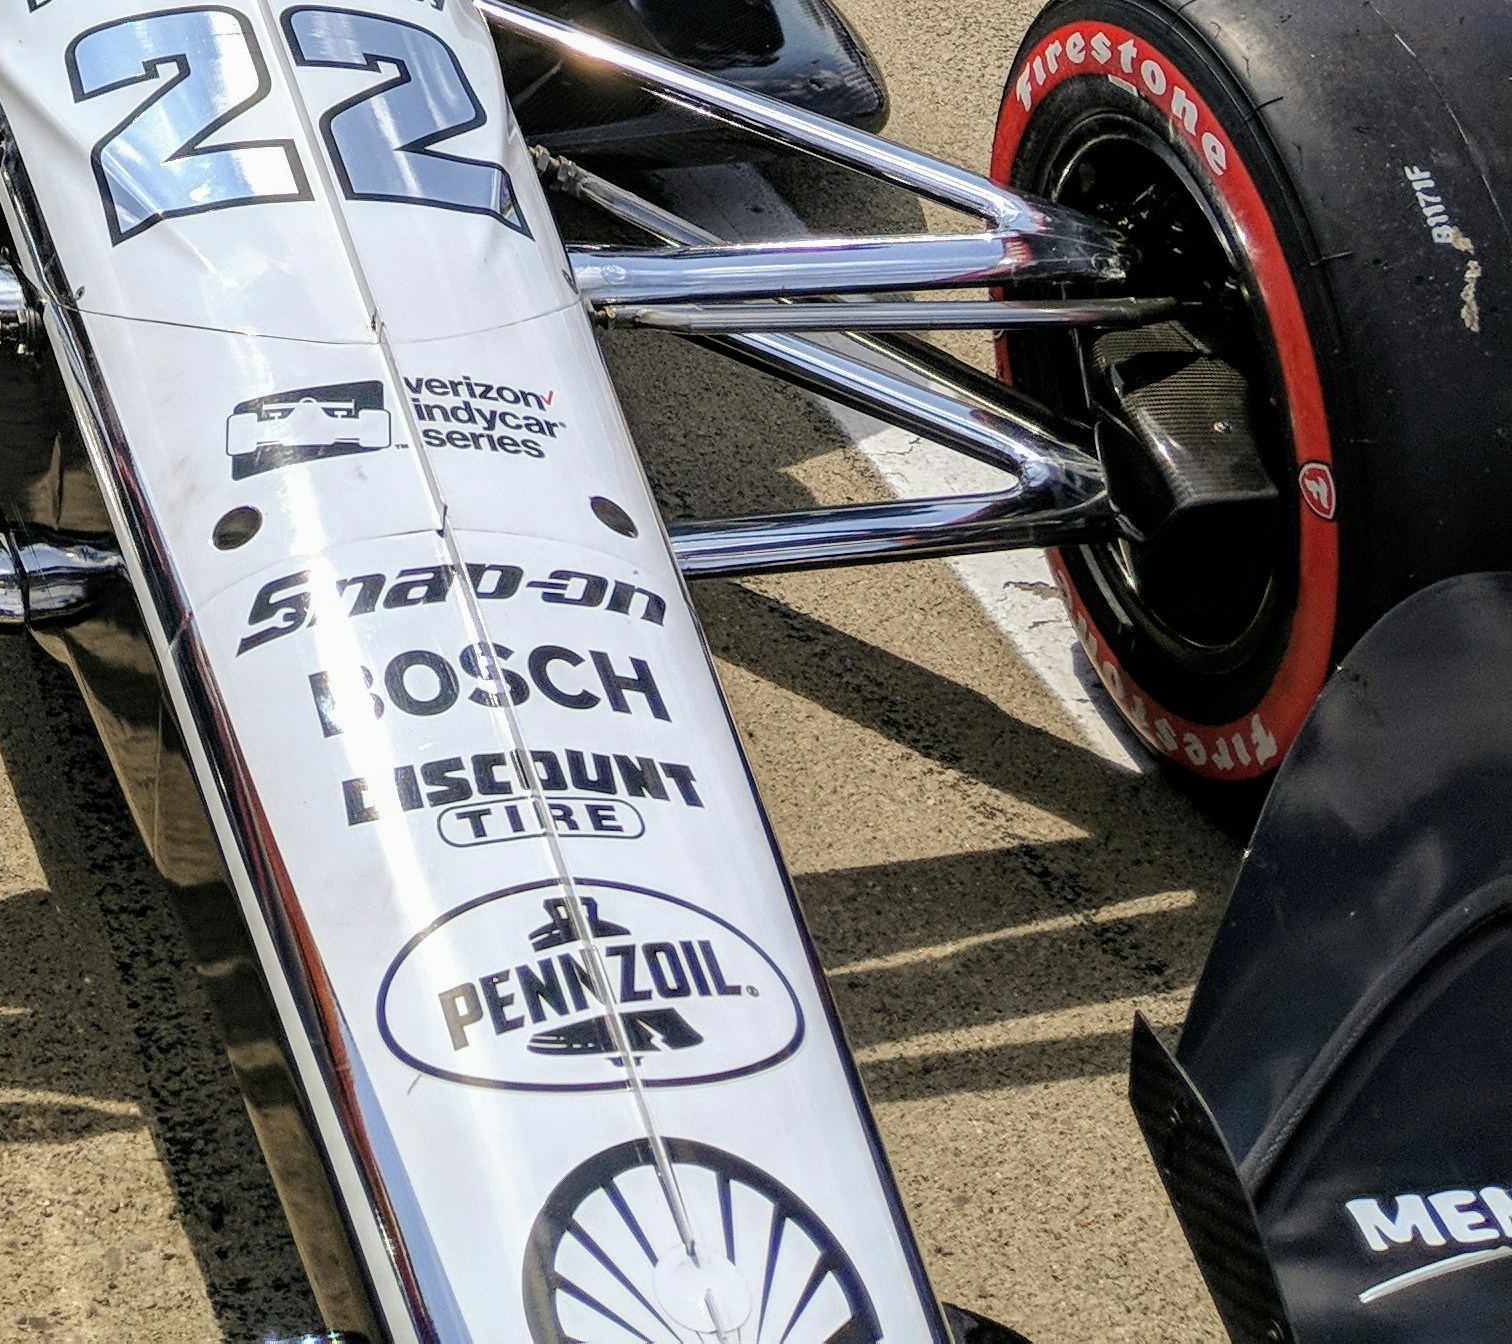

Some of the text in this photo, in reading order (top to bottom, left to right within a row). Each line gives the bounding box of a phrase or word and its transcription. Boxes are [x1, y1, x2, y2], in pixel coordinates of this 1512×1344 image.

[65, 4, 534, 247] 22
[1016, 31, 1227, 177] Firestone
[1404, 165, 1454, 244] B1171F
[403, 376, 547, 412] verizon
[411, 398, 558, 438] indycar
[422, 428, 546, 459] series
[235, 562, 666, 659] Snap-on
[308, 641, 673, 739] BOSCH
[342, 747, 706, 827] DISCOUNT
[456, 802, 625, 839] TIRE
[438, 939, 743, 1052] PENNZOIL
